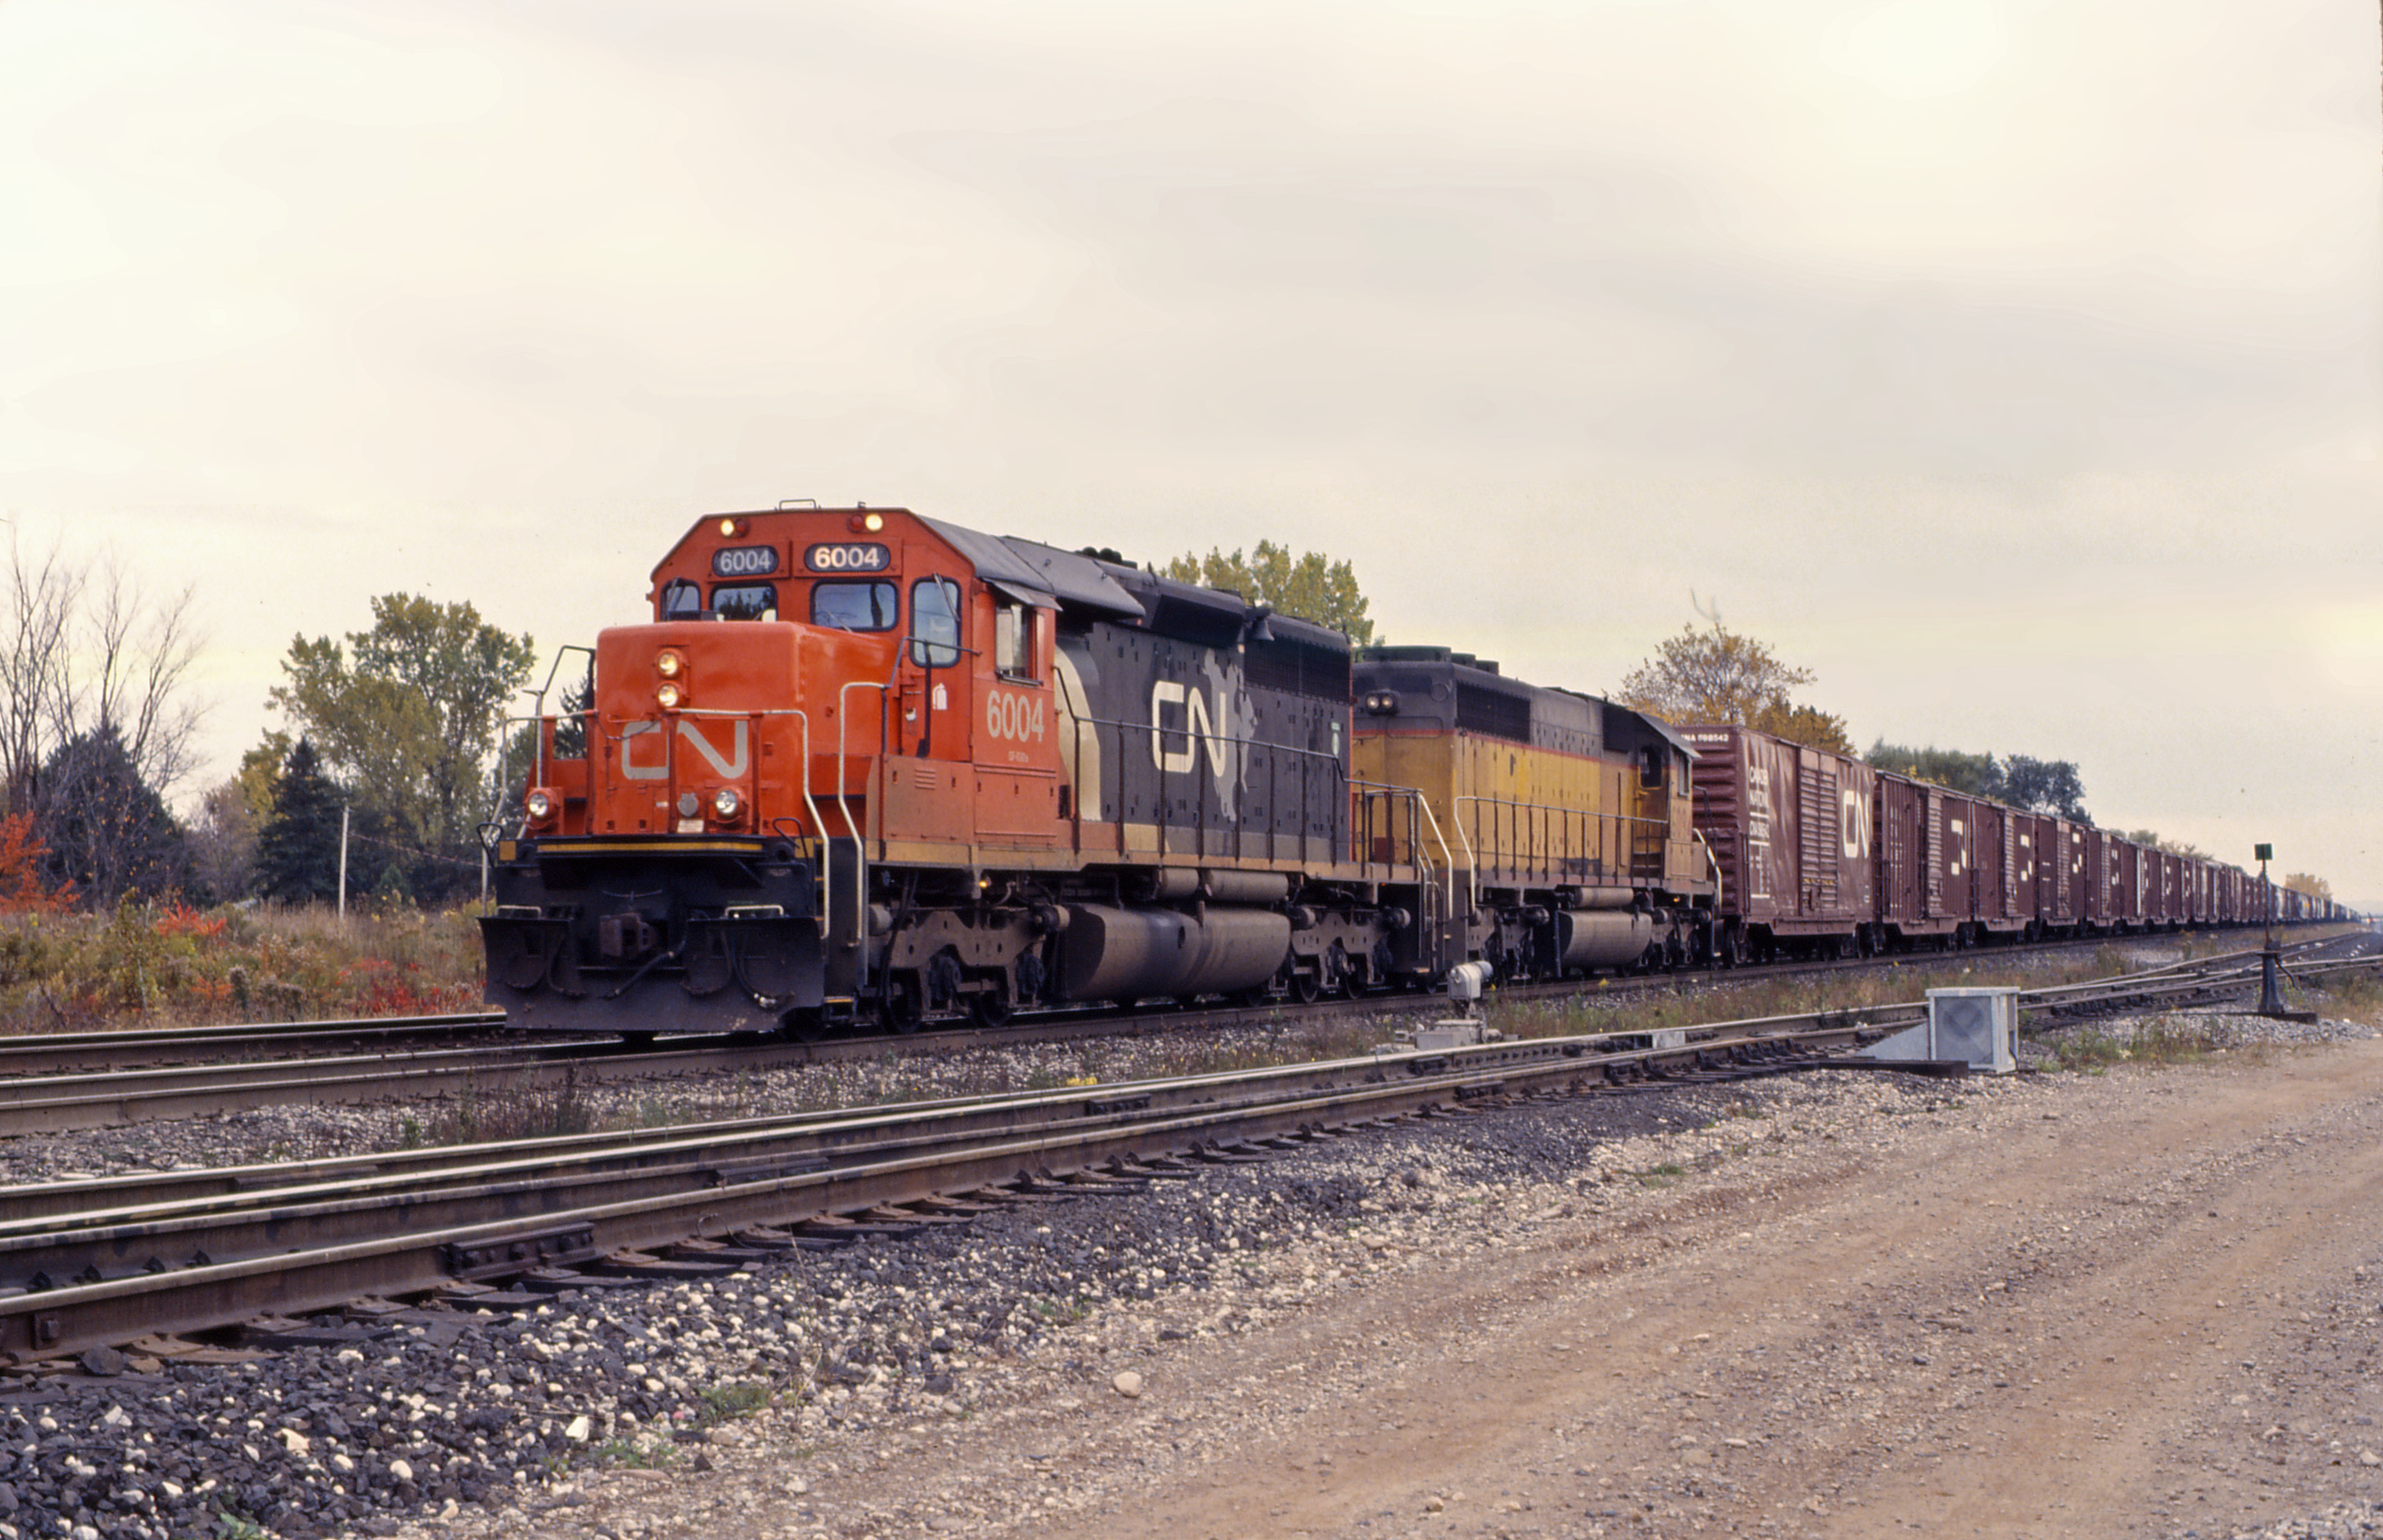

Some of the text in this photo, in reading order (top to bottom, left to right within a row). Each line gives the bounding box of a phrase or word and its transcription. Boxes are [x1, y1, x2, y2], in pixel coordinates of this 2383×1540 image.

[720, 549, 771, 572] 6004
[814, 546, 880, 568] 6004
[987, 690, 1044, 742] 6004
[1153, 681, 1226, 777] CN
[622, 721, 747, 779] CN
[1843, 790, 1870, 859] CN
